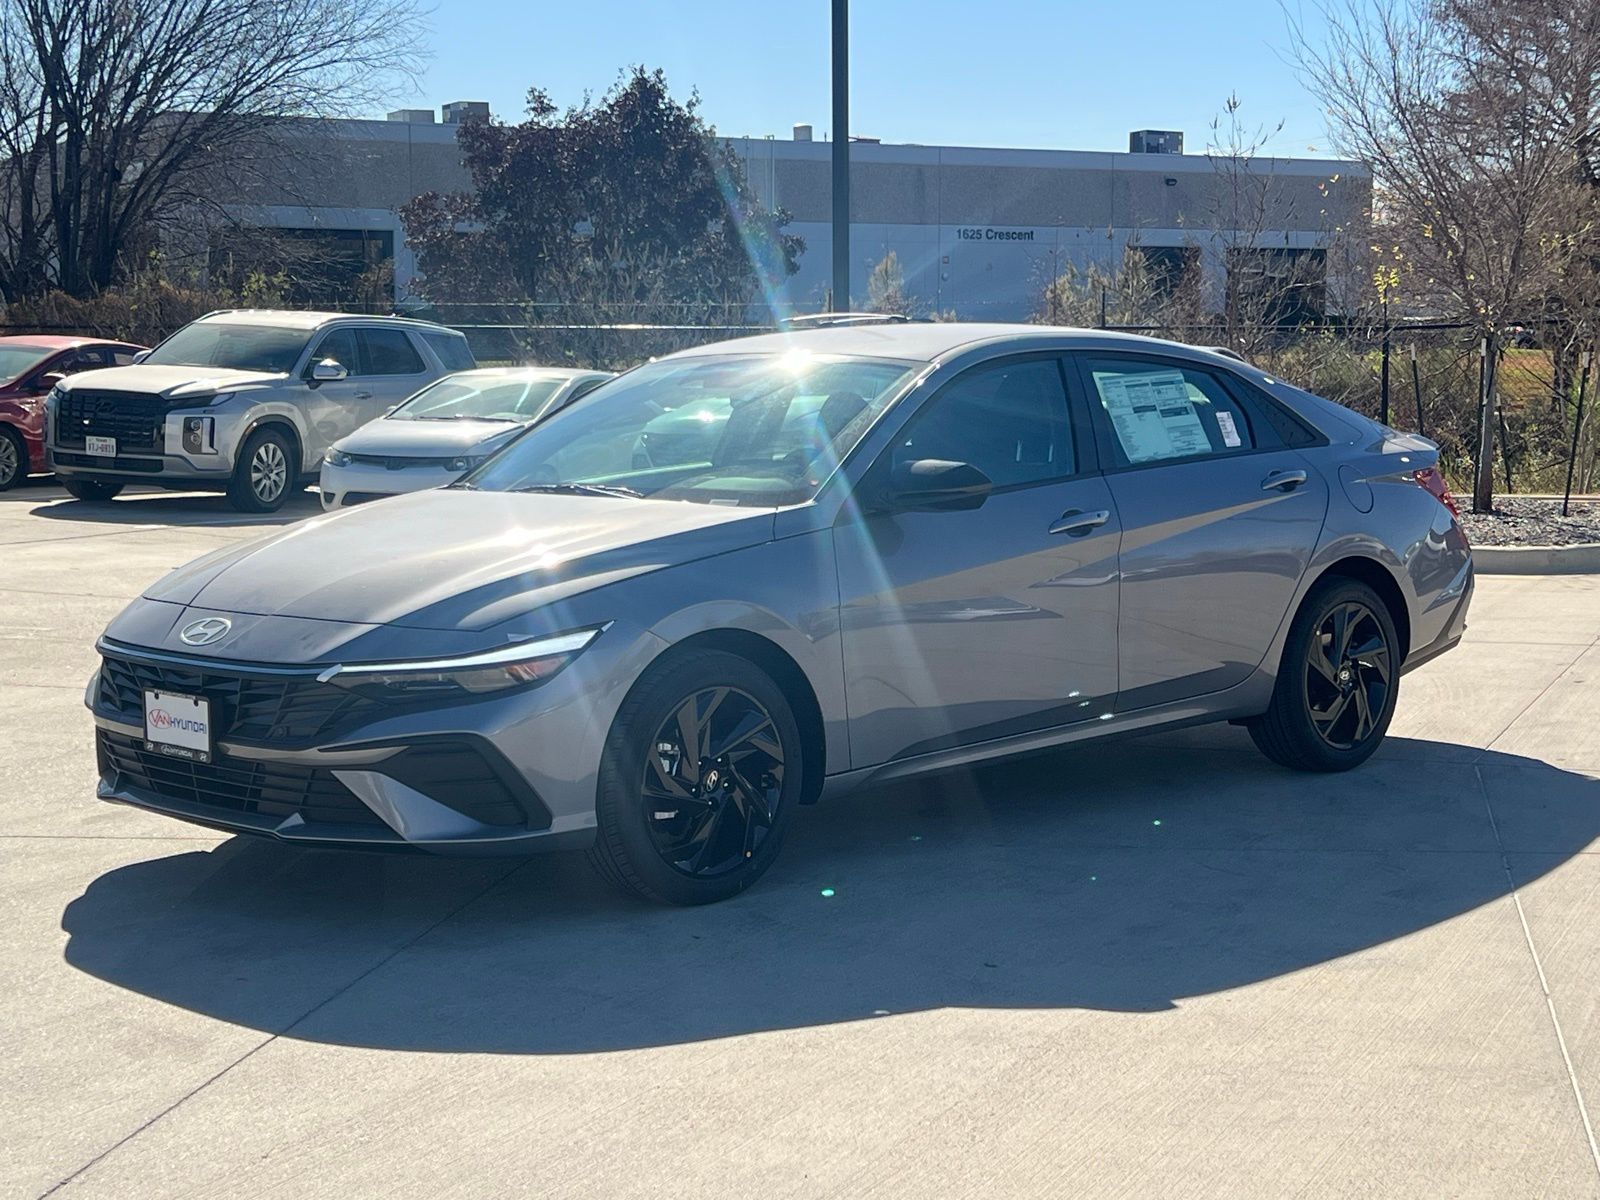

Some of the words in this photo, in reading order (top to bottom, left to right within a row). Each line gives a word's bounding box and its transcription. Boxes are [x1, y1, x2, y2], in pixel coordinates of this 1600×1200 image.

[956, 228, 982, 240] 1625
[985, 228, 1034, 241] Crescent
[150, 709, 171, 728] VAN
[170, 716, 208, 734] HYUNDAI
